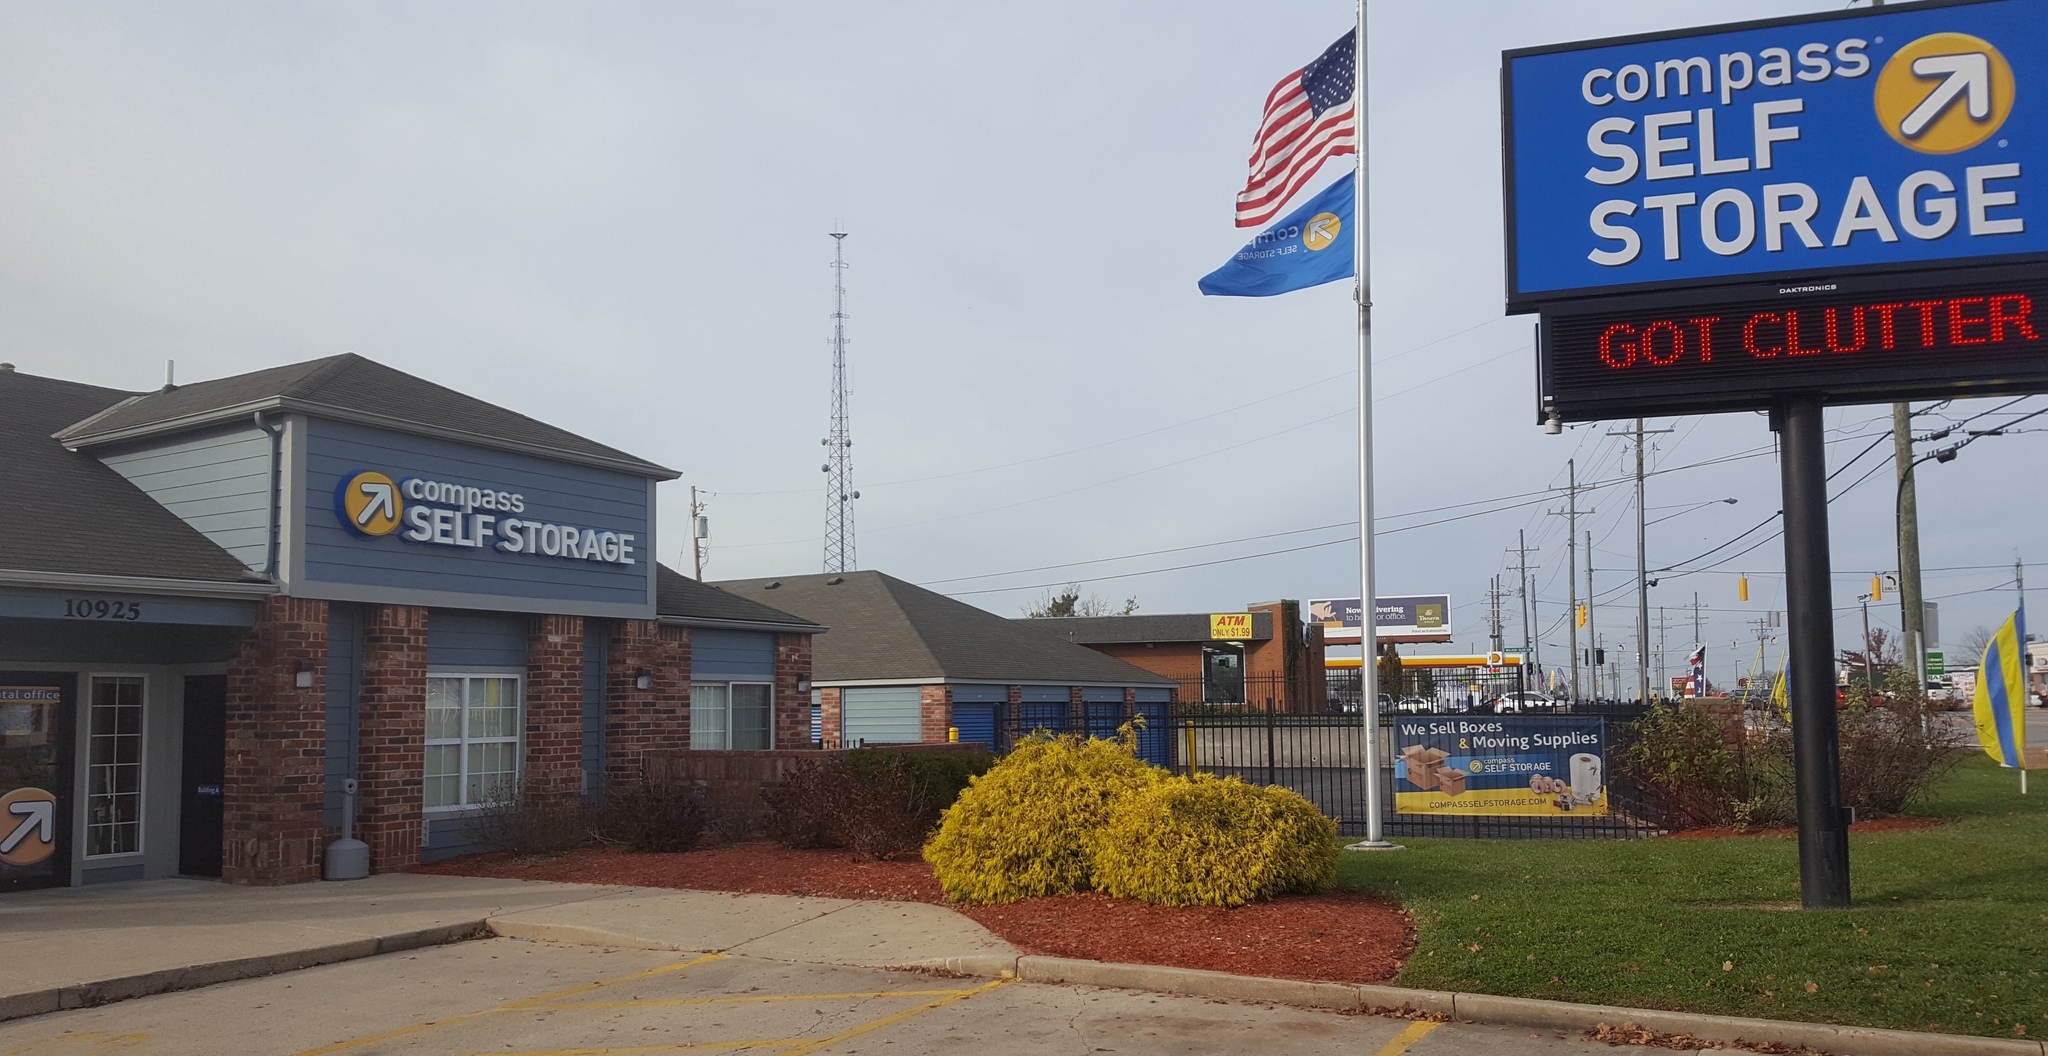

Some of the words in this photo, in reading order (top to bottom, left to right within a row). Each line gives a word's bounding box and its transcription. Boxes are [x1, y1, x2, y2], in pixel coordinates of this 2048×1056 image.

[1581, 38, 1870, 105] compass
[1584, 98, 1803, 186] SELF
[1586, 162, 2025, 267] STORAGE
[1779, 284, 1837, 294] DAKTRONICS
[1598, 316, 1720, 369] GOT
[1743, 293, 2040, 359] CLUTTER
[405, 478, 524, 513] compass
[403, 505, 495, 548] SELF
[497, 518, 636, 565] STORAGE
[64, 598, 141, 621] 10925
[1217, 615, 1246, 626] ATM
[1212, 628, 1230, 637] ONLY
[1231, 627, 1250, 637] $1.99
[0, 690, 19, 699] tal
[24, 689, 60, 700] office
[1401, 723, 1426, 736] We
[1429, 721, 1456, 735] Sell
[1459, 721, 1503, 734] Boxes
[1458, 737, 1470, 749] &
[1473, 734, 1530, 750] Moving
[1533, 731, 1598, 750] Supplies
[1483, 757, 1515, 765] compass
[1484, 763, 1508, 773] SELF
[1509, 761, 1552, 772] STORAGE
[1429, 798, 1547, 809] COMPASSSELFSTORAGE.COM
